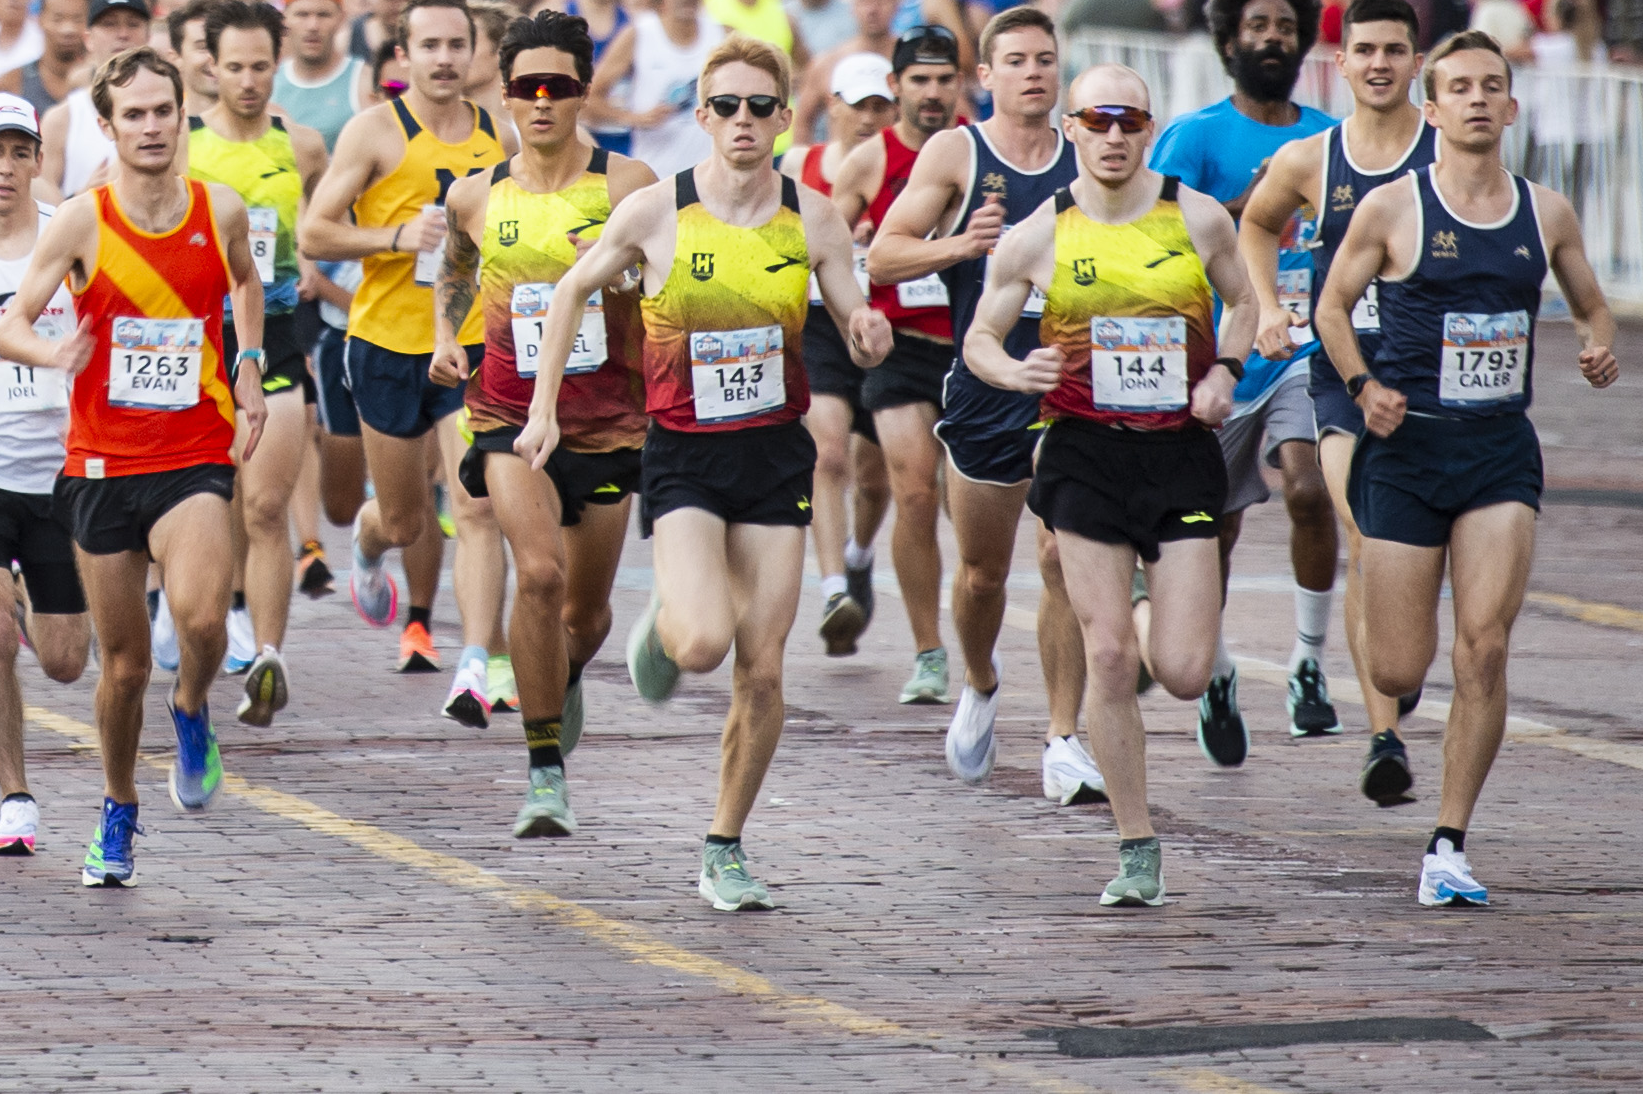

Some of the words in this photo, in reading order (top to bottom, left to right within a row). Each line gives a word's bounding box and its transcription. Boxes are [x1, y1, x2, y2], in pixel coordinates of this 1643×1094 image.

[527, 340, 591, 358] DEL
[124, 355, 189, 376] 1263
[1113, 356, 1166, 376] 144
[1455, 348, 1518, 372] 1793
[13, 366, 34, 383] 11
[715, 363, 764, 389] 143
[1459, 372, 1511, 388] CALEB
[8, 387, 36, 400] JOEL
[131, 377, 178, 392] EVAN
[724, 384, 758, 403] BEN
[1120, 377, 1159, 392] JOHN
